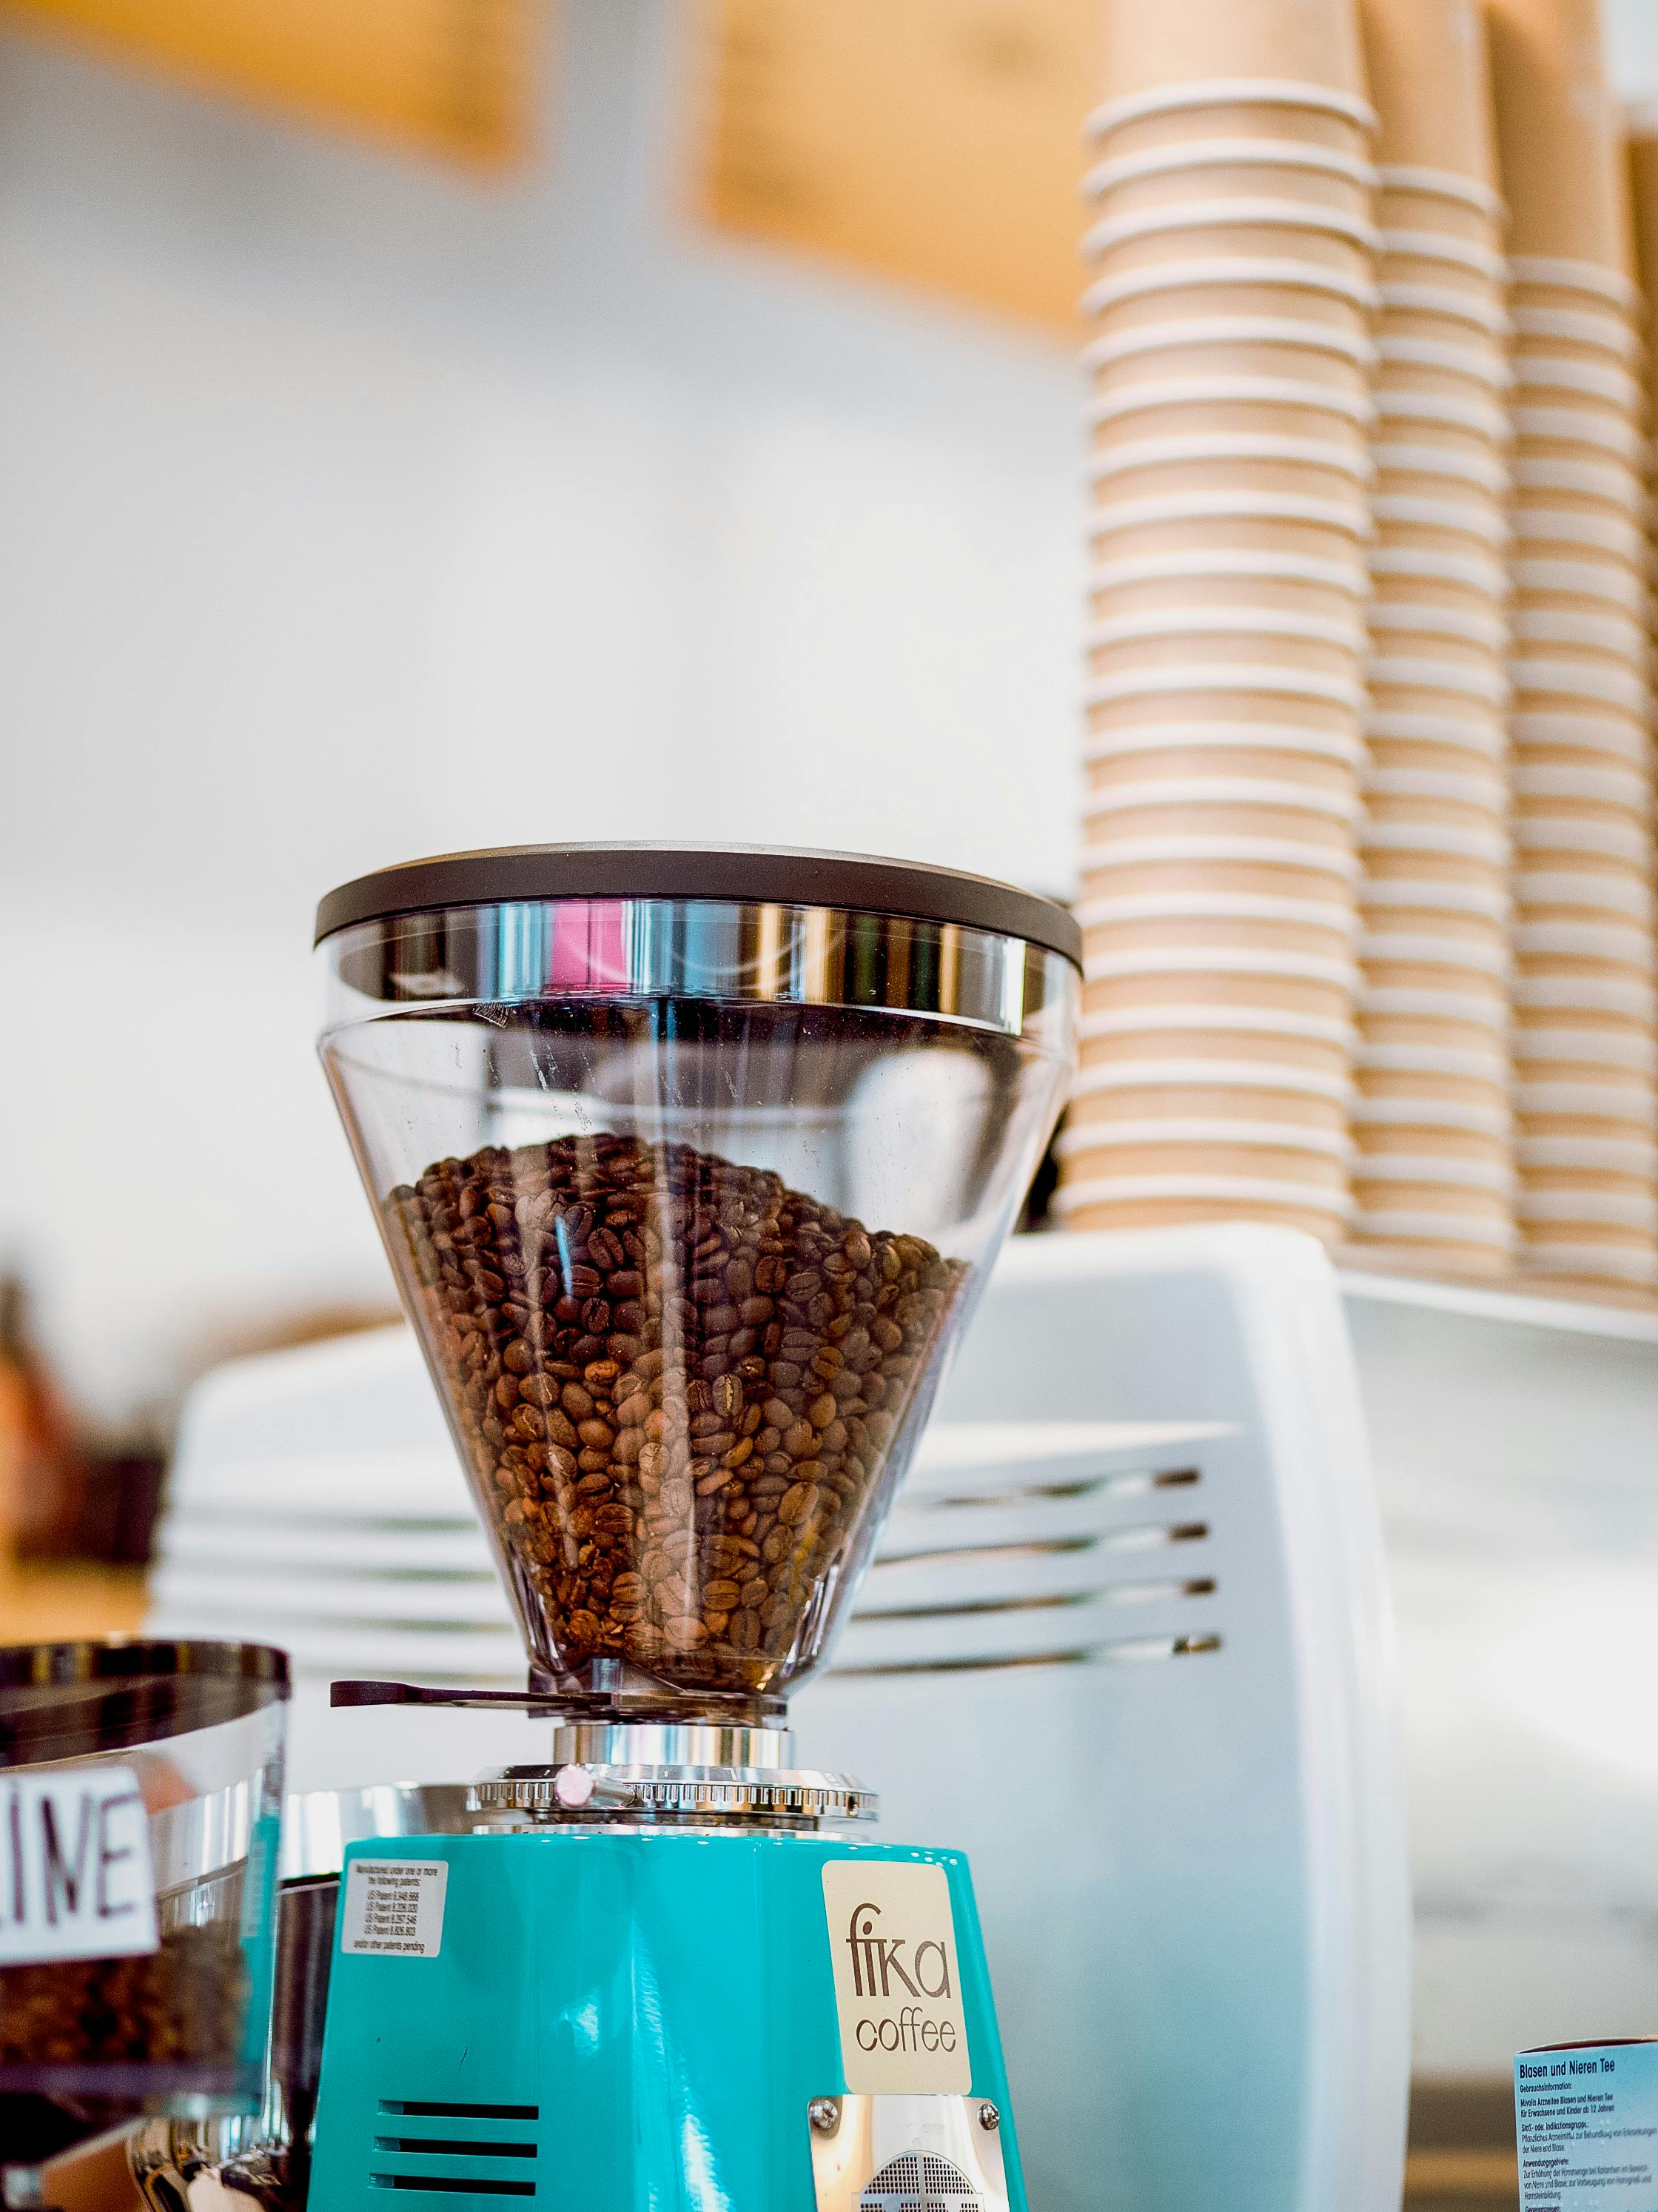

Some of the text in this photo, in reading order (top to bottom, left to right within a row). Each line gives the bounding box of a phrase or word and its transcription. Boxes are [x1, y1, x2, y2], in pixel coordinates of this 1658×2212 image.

[0, 1789, 139, 1926] INE
[423, 1868, 438, 1876] more
[403, 1941, 425, 1954] pending
[845, 1903, 951, 1999] fika
[856, 2006, 956, 2053] coffee
[1520, 2058, 1615, 2079] Blasen und Nieren Tee
[1520, 2082, 1573, 2094] Gebrauchsinformation:
[1560, 2095, 1577, 2105] Blasen
[1577, 2094, 1587, 2103] und
[1587, 2094, 1604, 2102] Nieren
[1605, 2093, 1614, 2101] Tee
[1528, 2108, 1555, 2117] Erwachsene
[1556, 2107, 1565, 2115] und
[1566, 2106, 1582, 2114] Kinder
[1583, 2105, 1589, 2114] ab
[1591, 2105, 1597, 2113] 12
[1597, 2104, 1615, 2113] Jahren
[1522, 2146, 1530, 2154] der
[1530, 2145, 1543, 2154] Niere
